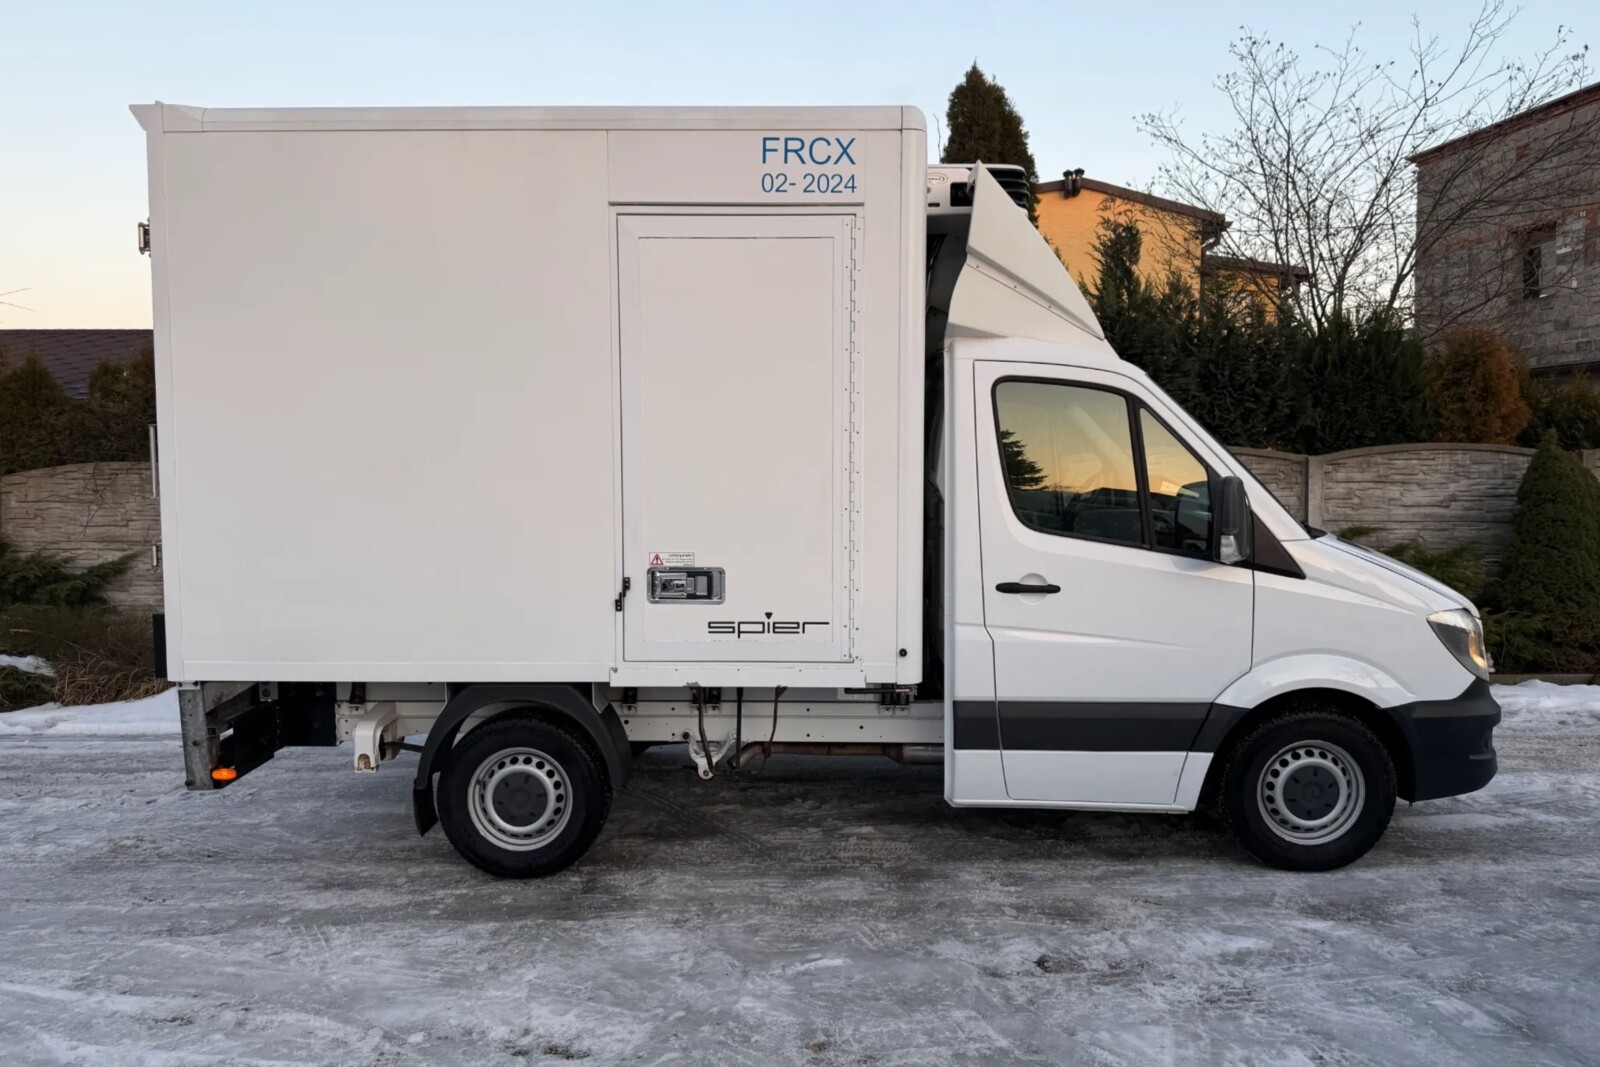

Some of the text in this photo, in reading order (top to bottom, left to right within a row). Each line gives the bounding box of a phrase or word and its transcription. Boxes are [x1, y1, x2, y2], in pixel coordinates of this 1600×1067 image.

[762, 137, 856, 165] FRCX
[803, 173, 857, 193] 2024
[708, 612, 830, 639] spier
